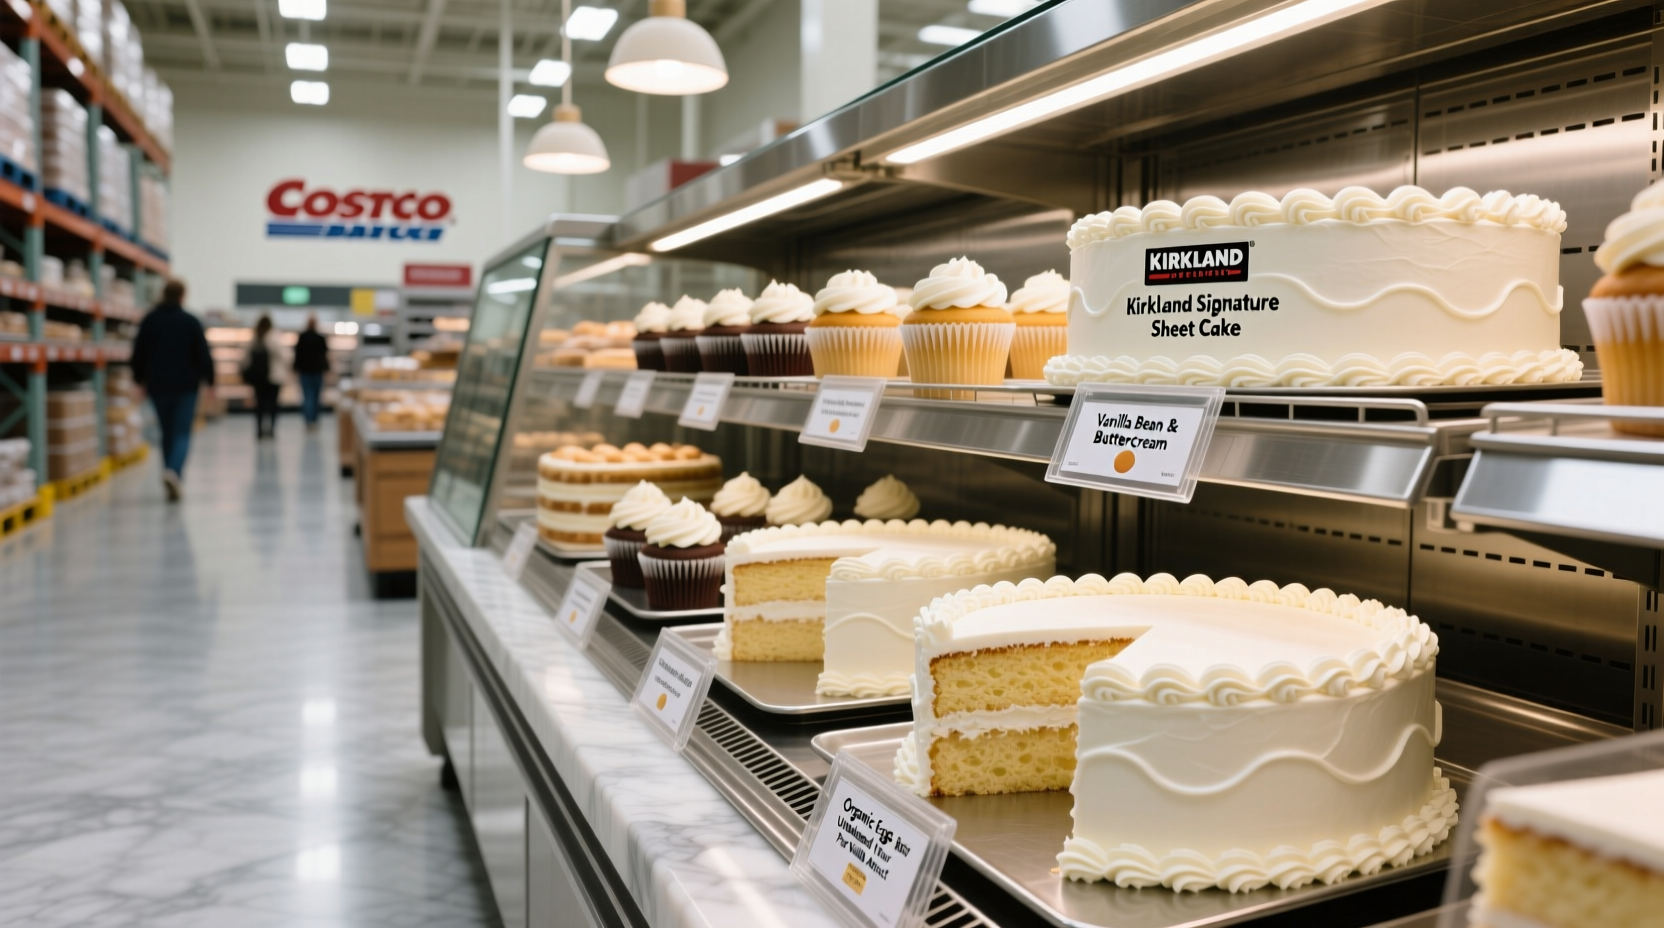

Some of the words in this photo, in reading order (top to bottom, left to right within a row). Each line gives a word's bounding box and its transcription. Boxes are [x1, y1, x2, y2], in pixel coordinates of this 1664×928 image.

[266, 179, 452, 220] COSTCO
[1149, 248, 1244, 271] KIRKLAND
[1126, 294, 1192, 315] Kirkland
[1151, 319, 1195, 337] Sheet
[1199, 318, 1241, 337] Cake
[1097, 413, 1132, 429] Vanilla
[1134, 416, 1164, 432] Bean
[1166, 418, 1179, 433] &
[843, 797, 875, 830] Organic
